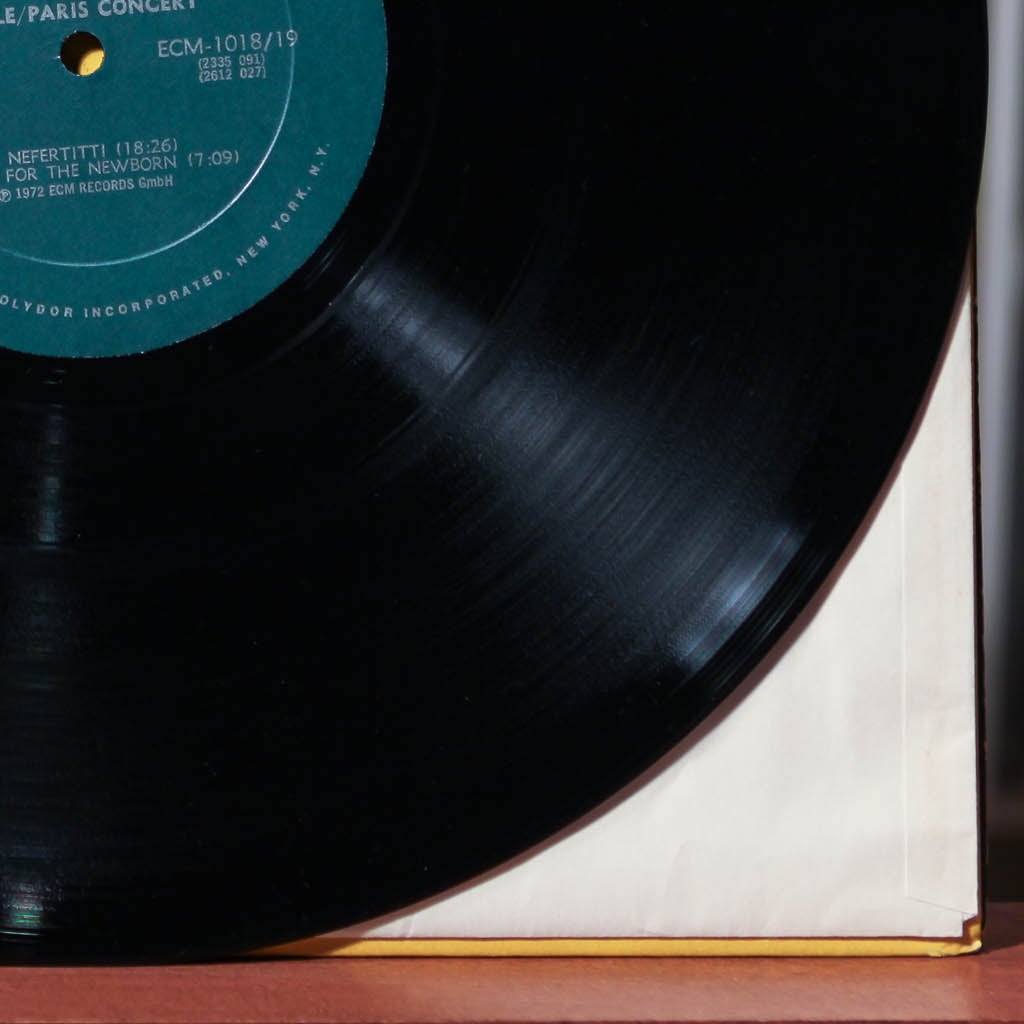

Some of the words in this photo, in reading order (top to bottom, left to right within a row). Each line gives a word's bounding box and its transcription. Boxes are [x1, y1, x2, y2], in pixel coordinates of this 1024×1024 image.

[157, 29, 298, 58] ECM-1018/19
[198, 56, 232, 71] (2335
[239, 53, 265, 66] 091)
[199, 69, 233, 83] (2612
[239, 66, 266, 79] 027)
[8, 143, 106, 165] NEFERTITTI
[116, 137, 178, 157] (18:26)
[6, 167, 38, 183] FOR
[46, 163, 80, 179] THE
[88, 155, 177, 176] NEWBORN
[187, 150, 240, 167] (7:09)
[16, 185, 45, 200] 1972
[49, 182, 75, 196] ECM
[79, 177, 135, 194] RECORDS
[138, 175, 174, 189] GmbH
[235, 235, 269, 267] NEW
[308, 142, 331, 177] N.Y.
